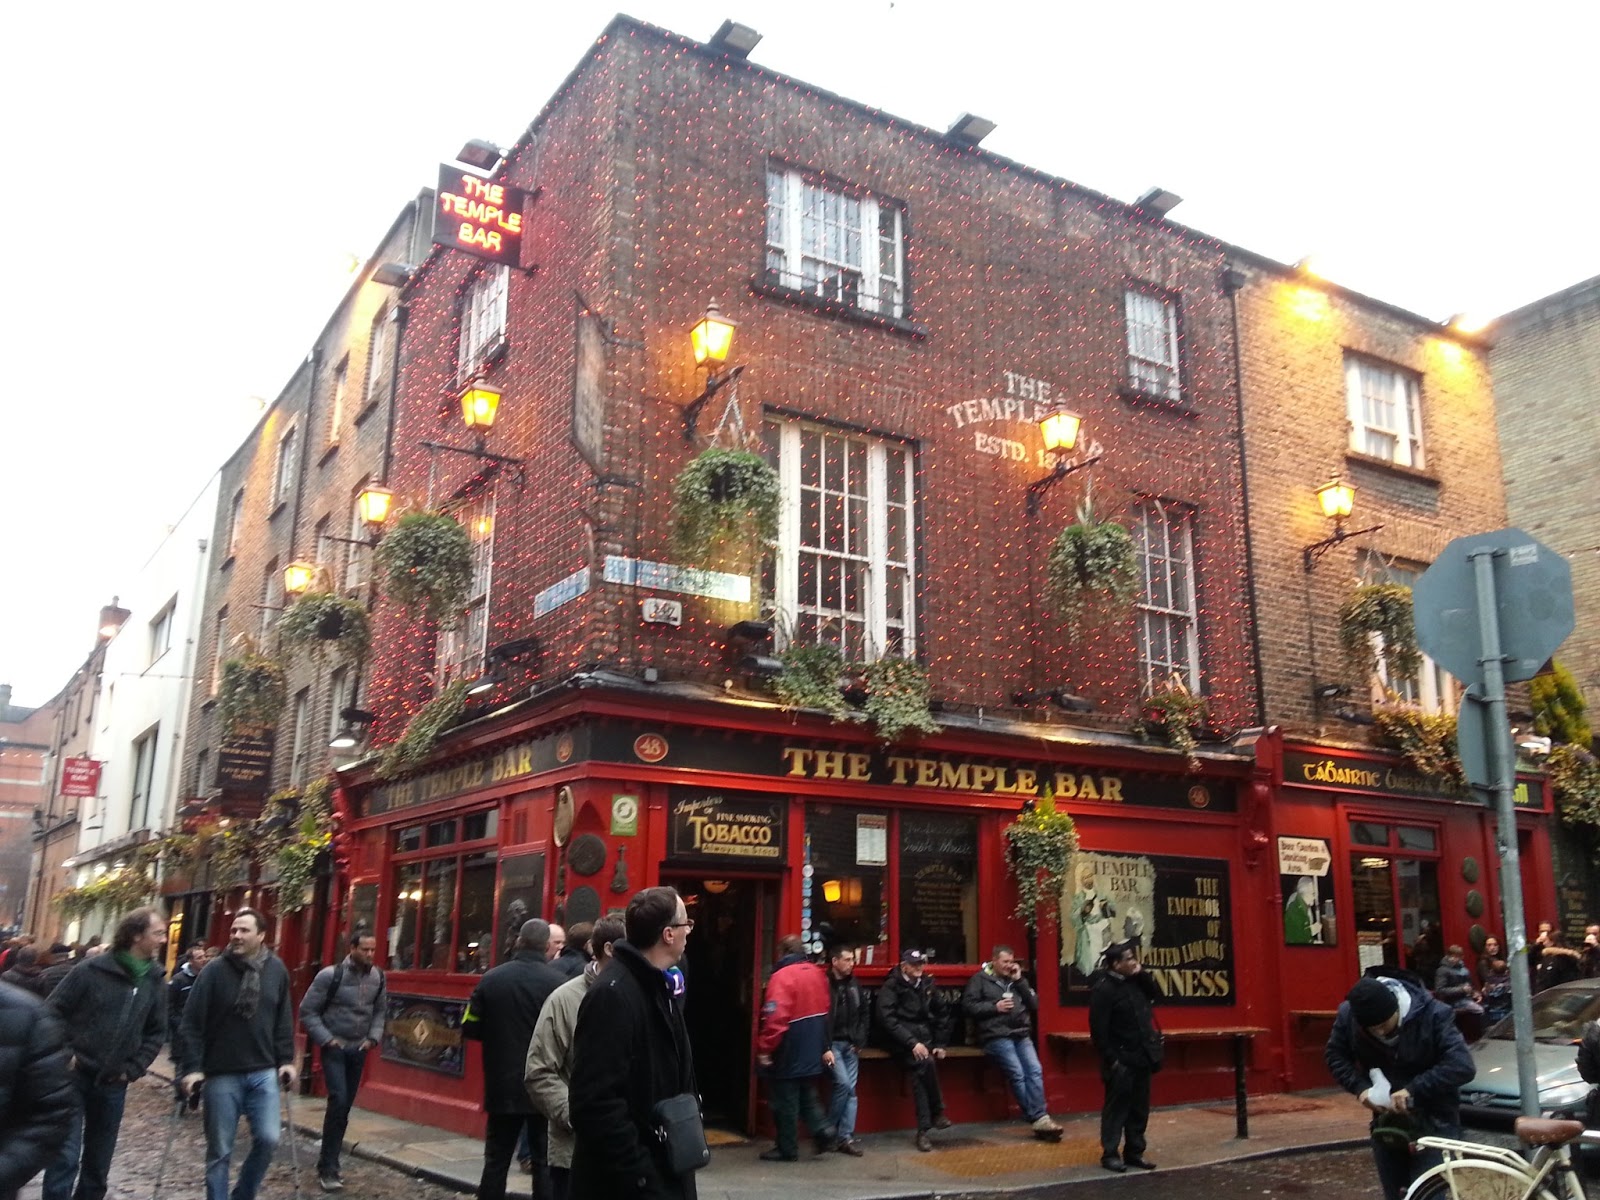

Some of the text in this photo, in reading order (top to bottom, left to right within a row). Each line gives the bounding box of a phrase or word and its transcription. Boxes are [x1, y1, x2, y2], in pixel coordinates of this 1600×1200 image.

[462, 174, 504, 205] THE
[440, 192, 521, 233] TEMPLE
[459, 222, 502, 252] BAR
[1004, 371, 1051, 404] THE
[946, 397, 1048, 428] TEMPLE
[641, 738, 662, 756] 48
[386, 746, 533, 811] THE TEMPLE BAR
[783, 747, 1124, 801] THE TEMPLE BAR
[686, 816, 772, 849] TOBACCO
[1092, 860, 1150, 878] TEMPLE
[1110, 877, 1140, 894] BAR
[1195, 877, 1219, 897] THE
[1166, 896, 1220, 918] EMPEROR
[1207, 920, 1220, 939] OF
[1145, 968, 1230, 997] NNESS
